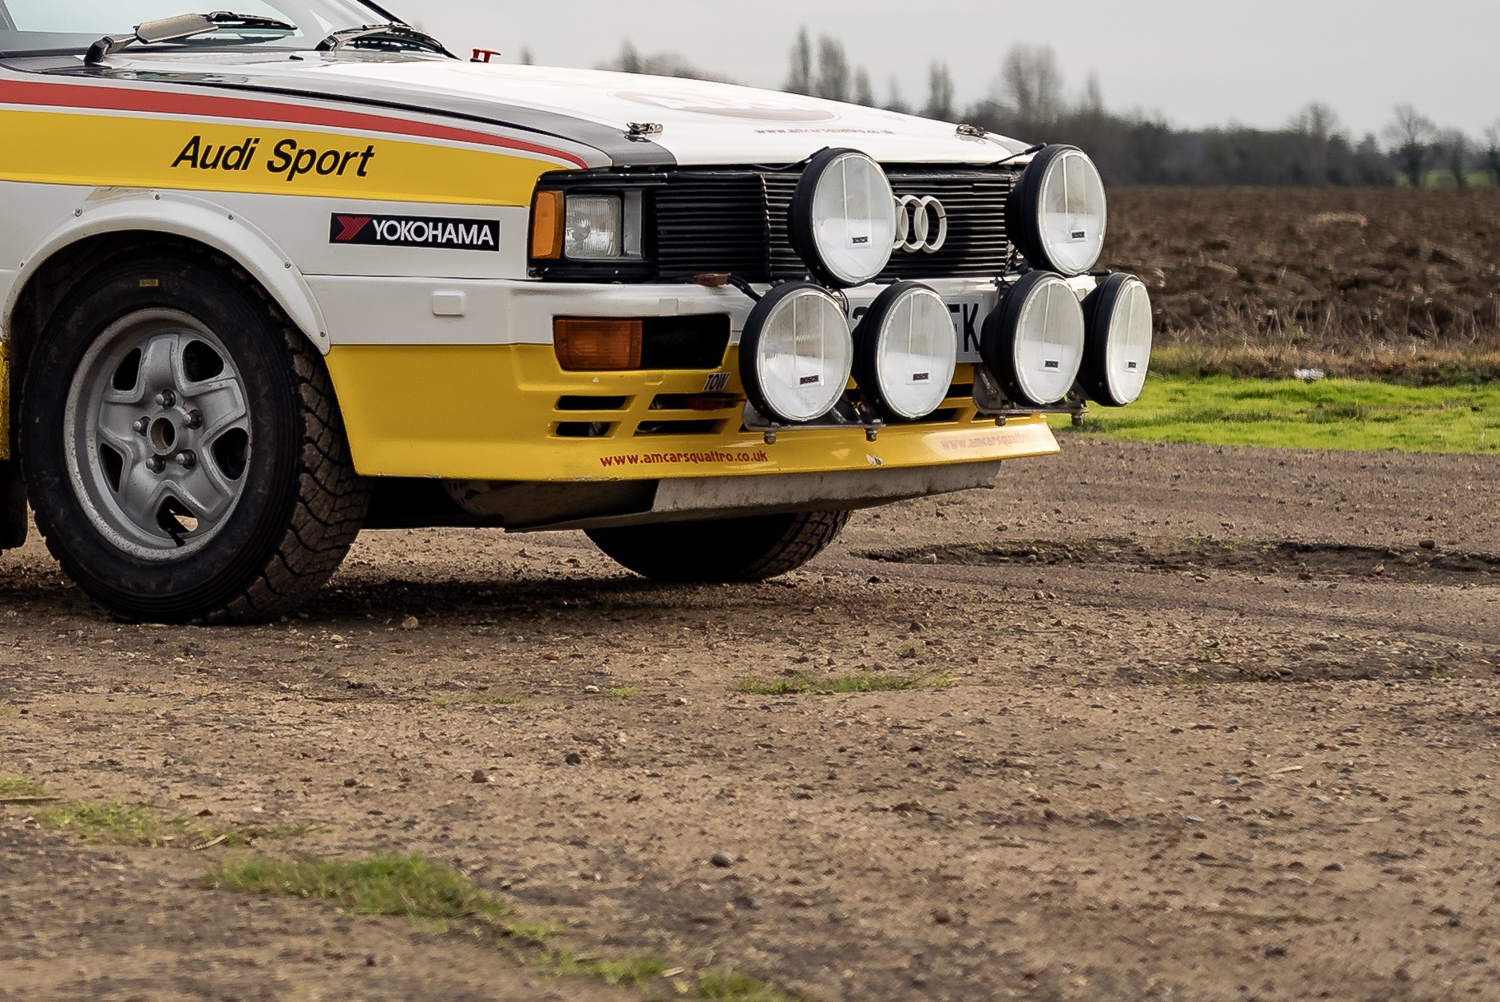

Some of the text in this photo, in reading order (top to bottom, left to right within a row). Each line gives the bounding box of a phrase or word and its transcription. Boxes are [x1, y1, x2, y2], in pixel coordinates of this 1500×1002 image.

[171, 135, 376, 182] Audi Sport
[372, 219, 495, 247] YOKOHAMA
[703, 372, 731, 392] TOW
[600, 449, 769, 468] www.amcarsquattro.co.uk
